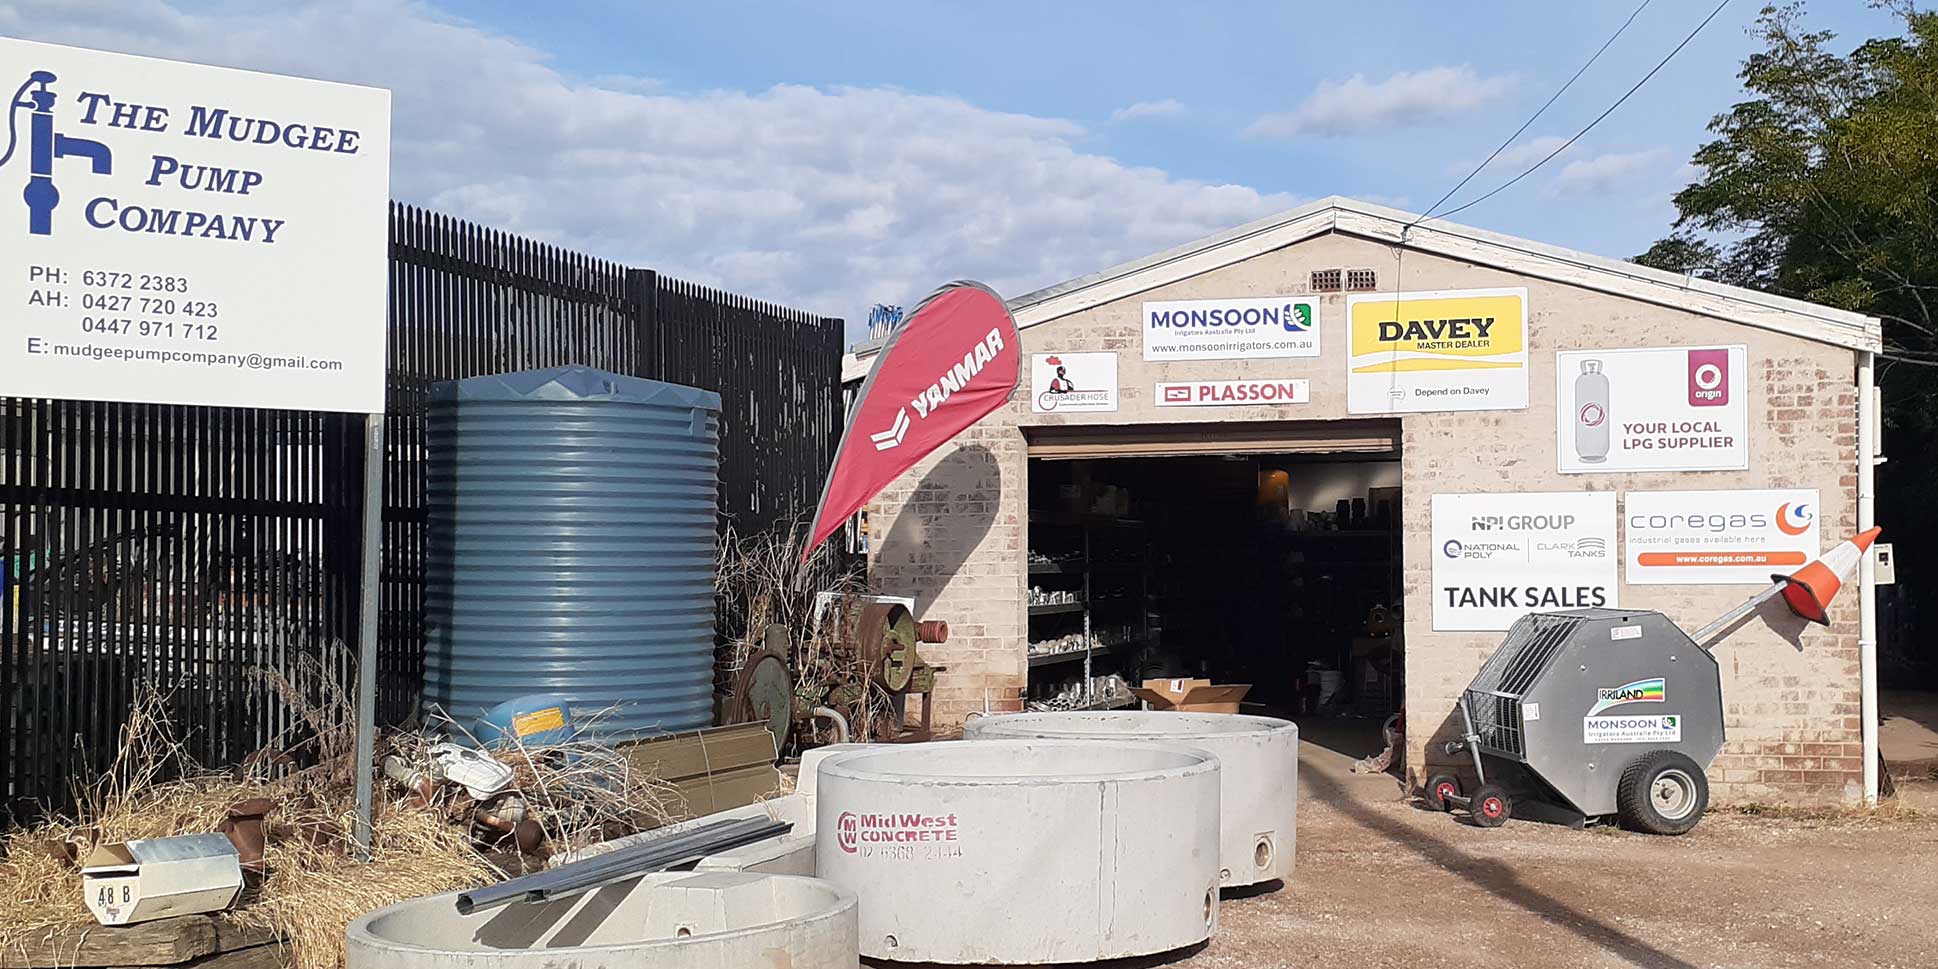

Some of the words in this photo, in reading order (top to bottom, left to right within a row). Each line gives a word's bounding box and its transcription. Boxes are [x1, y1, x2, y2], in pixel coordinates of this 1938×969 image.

[77, 91, 170, 134] THE
[184, 105, 361, 155] MUDGEE
[146, 155, 264, 195] PUMP
[85, 197, 286, 245] COMPANY
[29, 266, 69, 285] PH:
[82, 270, 133, 290] 6372
[140, 274, 189, 294] 2383
[28, 290, 70, 308] AH:
[82, 293, 132, 312] 0427
[139, 296, 176, 315] 720
[182, 299, 219, 318] 423
[1151, 307, 1279, 329] MONSOON
[82, 316, 132, 335] 0447
[139, 319, 174, 338] 971
[182, 322, 219, 341] 712
[1174, 329, 1203, 337] Irrigators
[1204, 328, 1232, 336] Australia
[1233, 328, 1244, 336] Pty
[1378, 317, 1495, 342] DAVEY
[1152, 340, 1313, 353] www.monsoonirrigators.com.au
[1416, 340, 1453, 350] MASTER
[1455, 339, 1490, 349] DEALER
[27, 338, 49, 355] E:
[53, 342, 343, 371] mudgeepumpcompany@gmail.com
[910, 327, 1005, 420] YANMAR
[1043, 393, 1087, 402] CRUSADER
[1087, 393, 1109, 401] HOSE
[1199, 383, 1294, 402] PLASSON
[1415, 387, 1448, 399] Depend
[1450, 388, 1462, 396] on
[1463, 386, 1490, 398] Davey
[1695, 389, 1722, 400] origin
[1623, 422, 1668, 435] YOUR
[1671, 421, 1722, 434] LOCAL
[1623, 438, 1653, 450] LPG
[1657, 436, 1734, 449] SUPPLIER
[1507, 515, 1576, 531] GROUP
[1630, 514, 1767, 533] coregas
[1463, 543, 1521, 551] NATIONAL
[1536, 542, 1576, 551] CLARK
[1629, 536, 1672, 544] industrial
[1674, 537, 1701, 545] gases
[1703, 535, 1742, 544] available
[1744, 535, 1766, 543] here
[1463, 551, 1493, 559] POLY
[1567, 550, 1606, 558] TANKS
[1676, 555, 1767, 565] www.coregas.com.au
[1443, 586, 1519, 608] TANK
[1524, 586, 1606, 608] SALES
[1599, 689, 1644, 700] IRRILAND
[1587, 719, 1657, 730] MONSOON
[860, 814, 897, 828] Mid
[899, 813, 958, 828] West
[860, 829, 958, 842] CONCRETE
[122, 885, 130, 903] B
